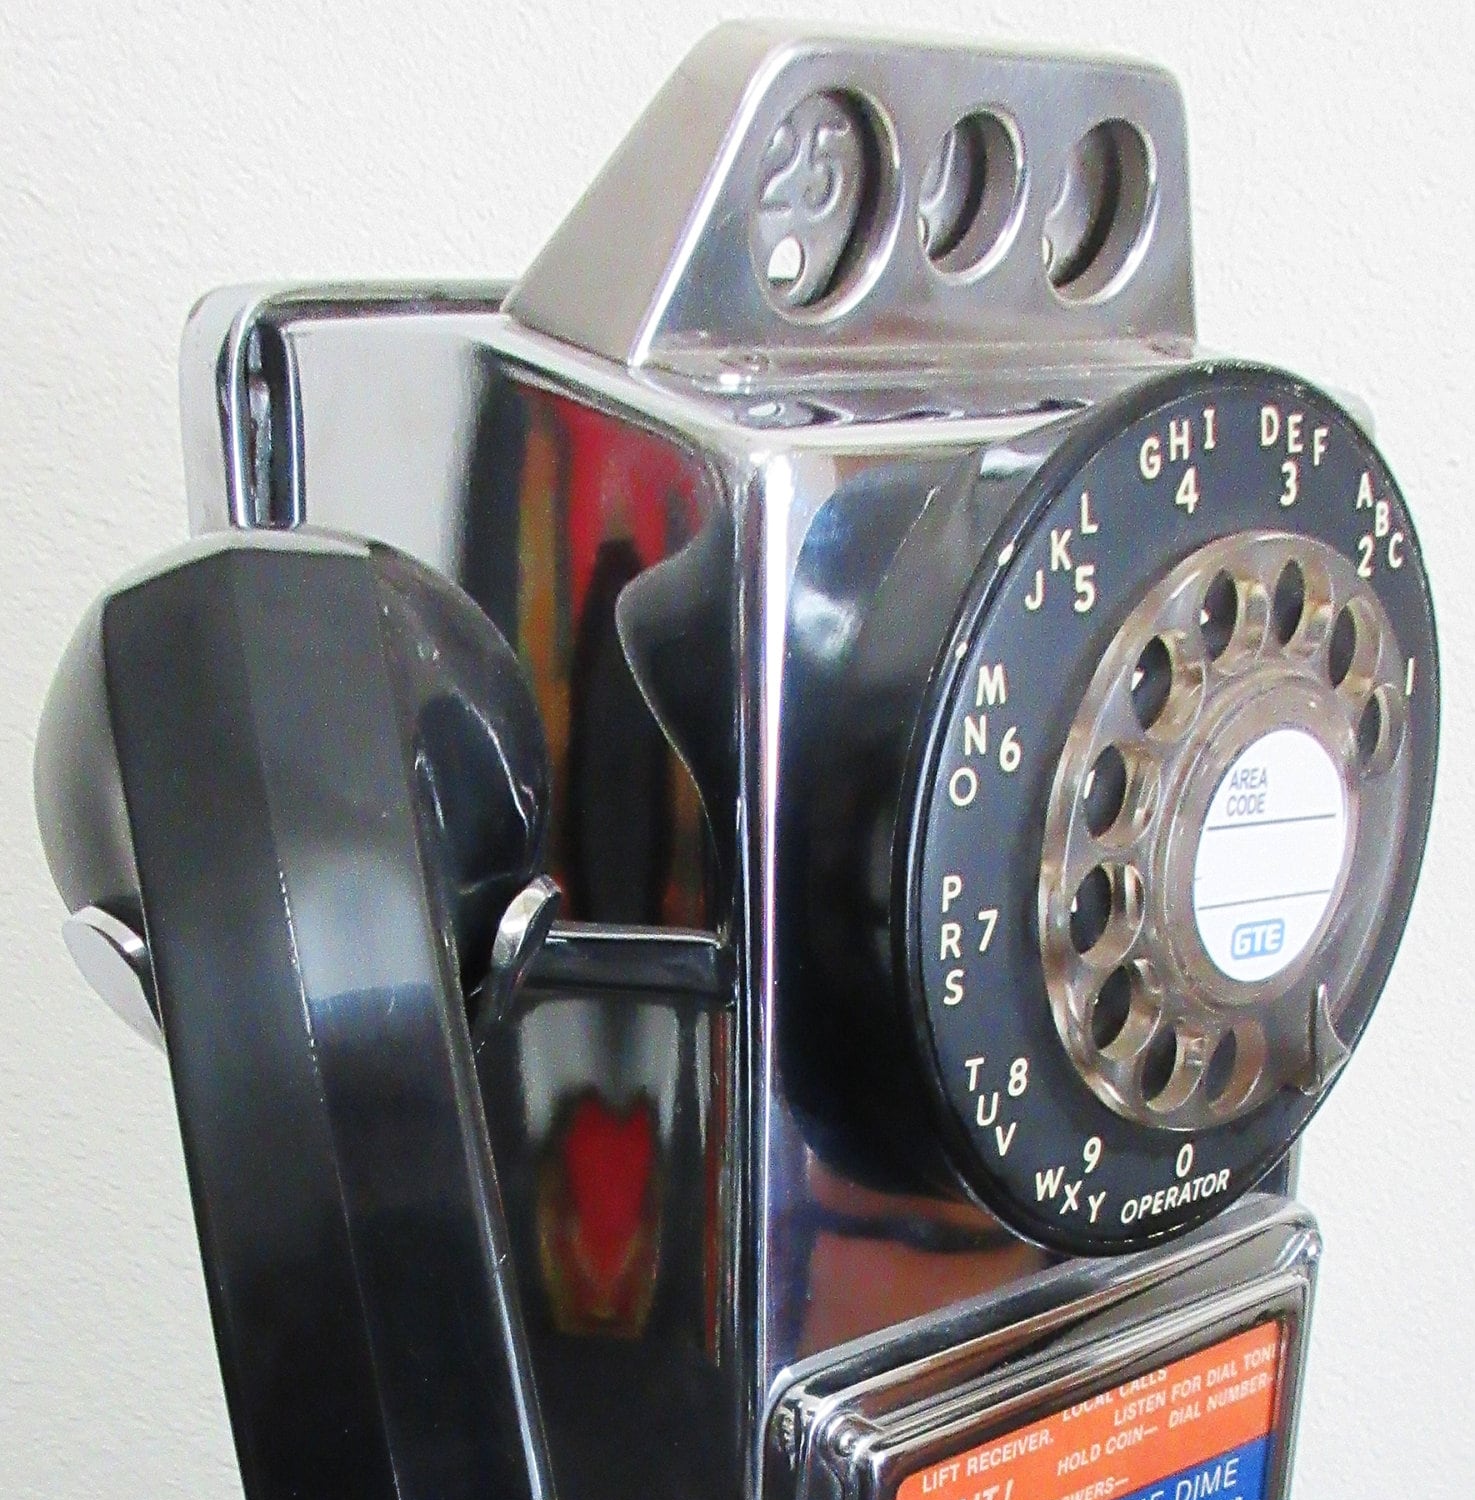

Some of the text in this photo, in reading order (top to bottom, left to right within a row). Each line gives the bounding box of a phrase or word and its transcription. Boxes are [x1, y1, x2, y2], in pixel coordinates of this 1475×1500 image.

[762, 113, 852, 221] 25
[1175, 467, 1200, 515] 4
[1279, 461, 1300, 507] 3
[1356, 534, 1376, 578] 2
[1074, 564, 1096, 613] 5
[999, 726, 1023, 773] 6
[1229, 767, 1268, 791] AREA
[1226, 793, 1267, 817] CODE
[977, 909, 999, 953] 7
[1233, 921, 1284, 958] GTE
[1007, 1057, 1030, 1098] 8
[1083, 1136, 1102, 1175] 9
[1120, 1168, 1231, 1226] OPERATOR
[1062, 1368, 1168, 1423] LOCAL CALLS
[922, 1463, 961, 1494] LIFT
[966, 1428, 1054, 1478] RECEIVER.
[1114, 1391, 1167, 1427] LISTEN
[1171, 1375, 1203, 1402] FOR
[1206, 1361, 1239, 1388] DIAL
[1056, 1443, 1101, 1477] HOLD
[1168, 1402, 1202, 1430] DIAL
